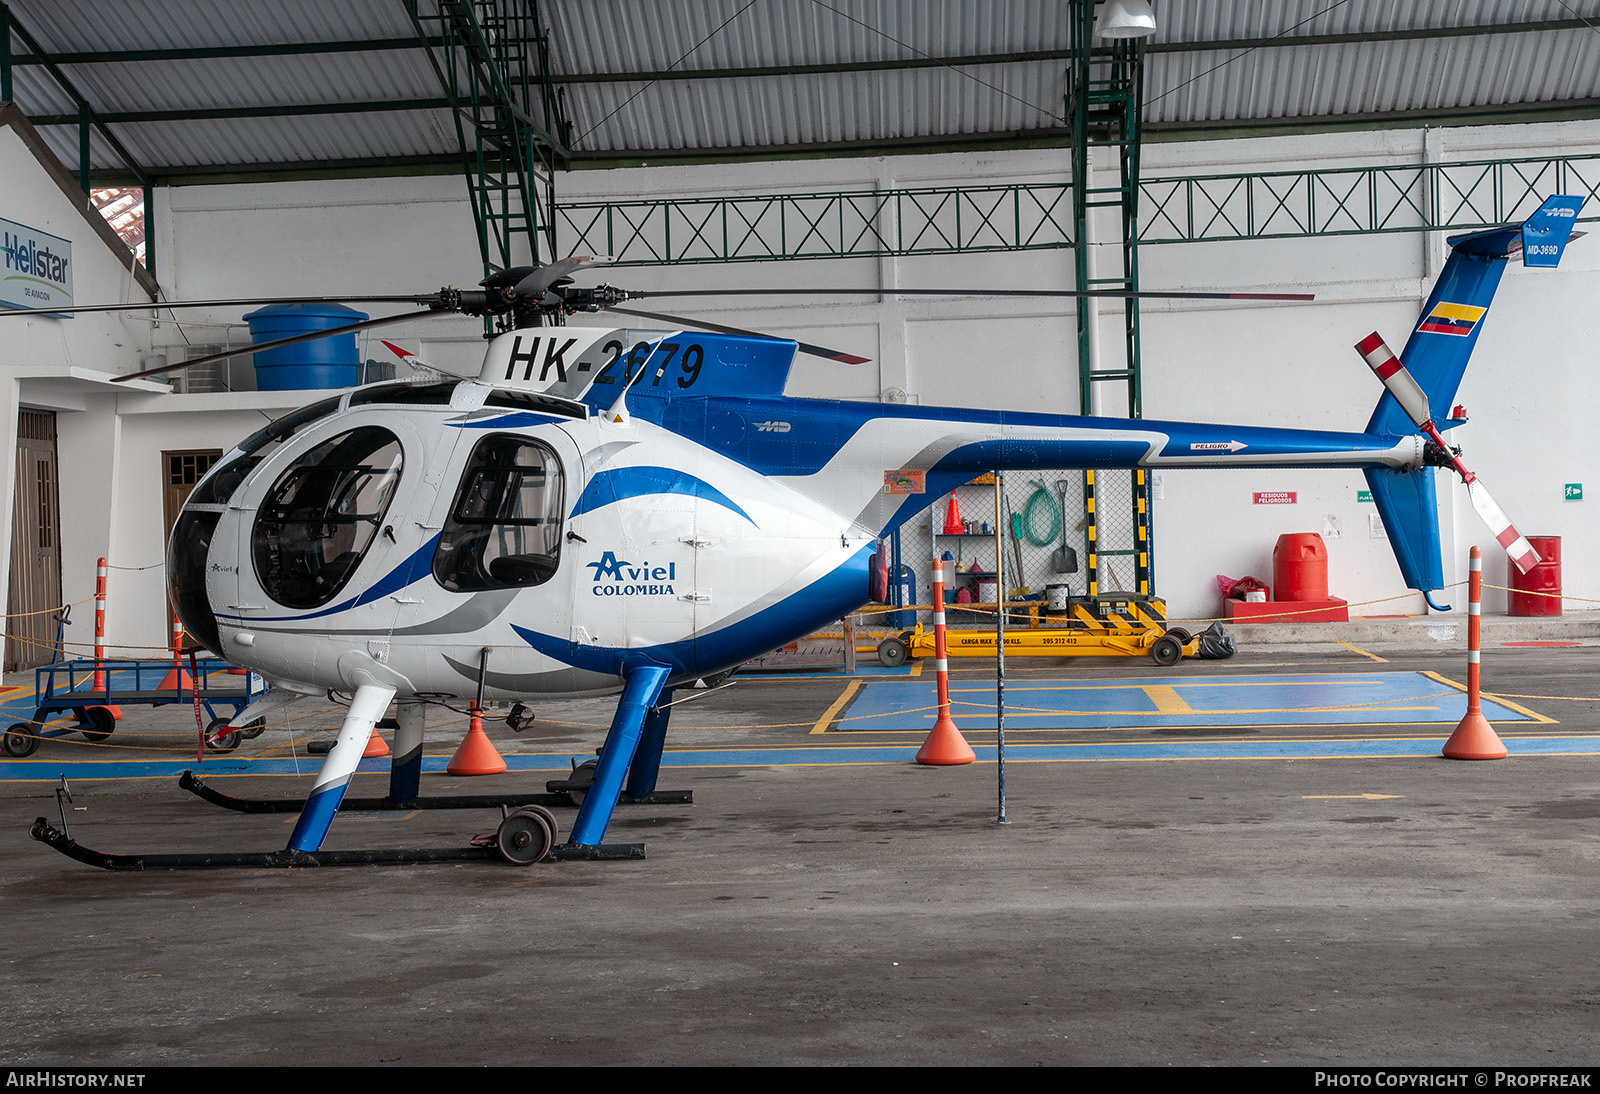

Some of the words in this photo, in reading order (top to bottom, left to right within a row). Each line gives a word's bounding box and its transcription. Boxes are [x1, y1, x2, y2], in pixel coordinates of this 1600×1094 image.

[4, 231, 68, 284] Helistar
[1527, 245, 1558, 255] MD-369D
[24, 287, 31, 297] DE
[505, 335, 704, 389] HK-2679
[586, 551, 675, 581] Aviel
[592, 584, 675, 597] COLOMBIA
